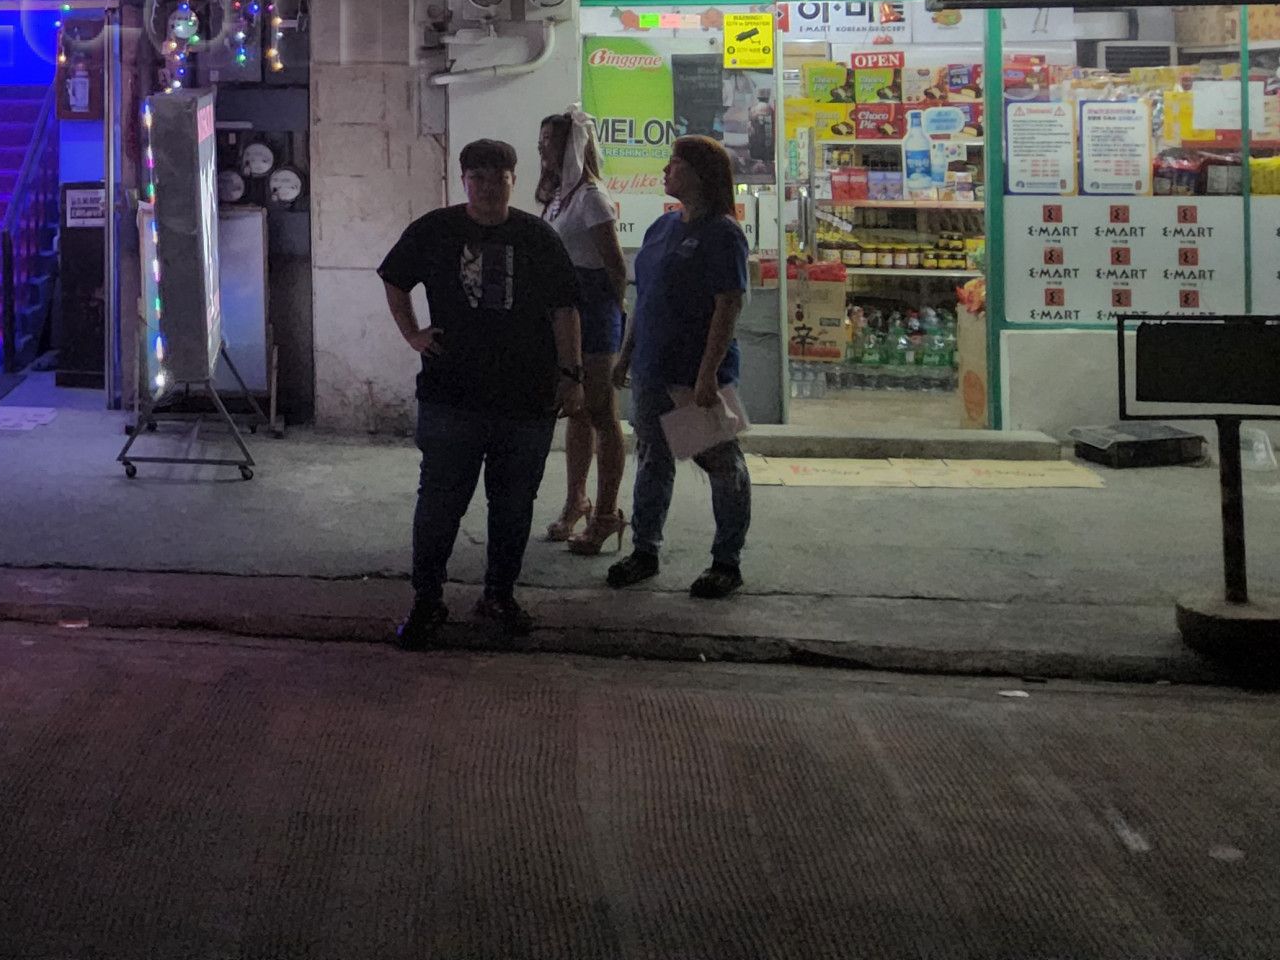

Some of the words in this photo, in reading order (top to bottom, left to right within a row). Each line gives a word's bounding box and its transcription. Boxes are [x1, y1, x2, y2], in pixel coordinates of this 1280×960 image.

[589, 48, 663, 69] Binggrae
[855, 53, 900, 68] OPEN
[858, 111, 889, 121] Choco
[591, 117, 676, 145] MELON
[859, 120, 877, 130] Pie
[601, 147, 649, 158] FRESHING
[652, 148, 668, 158] ICE
[607, 176, 628, 193] lky
